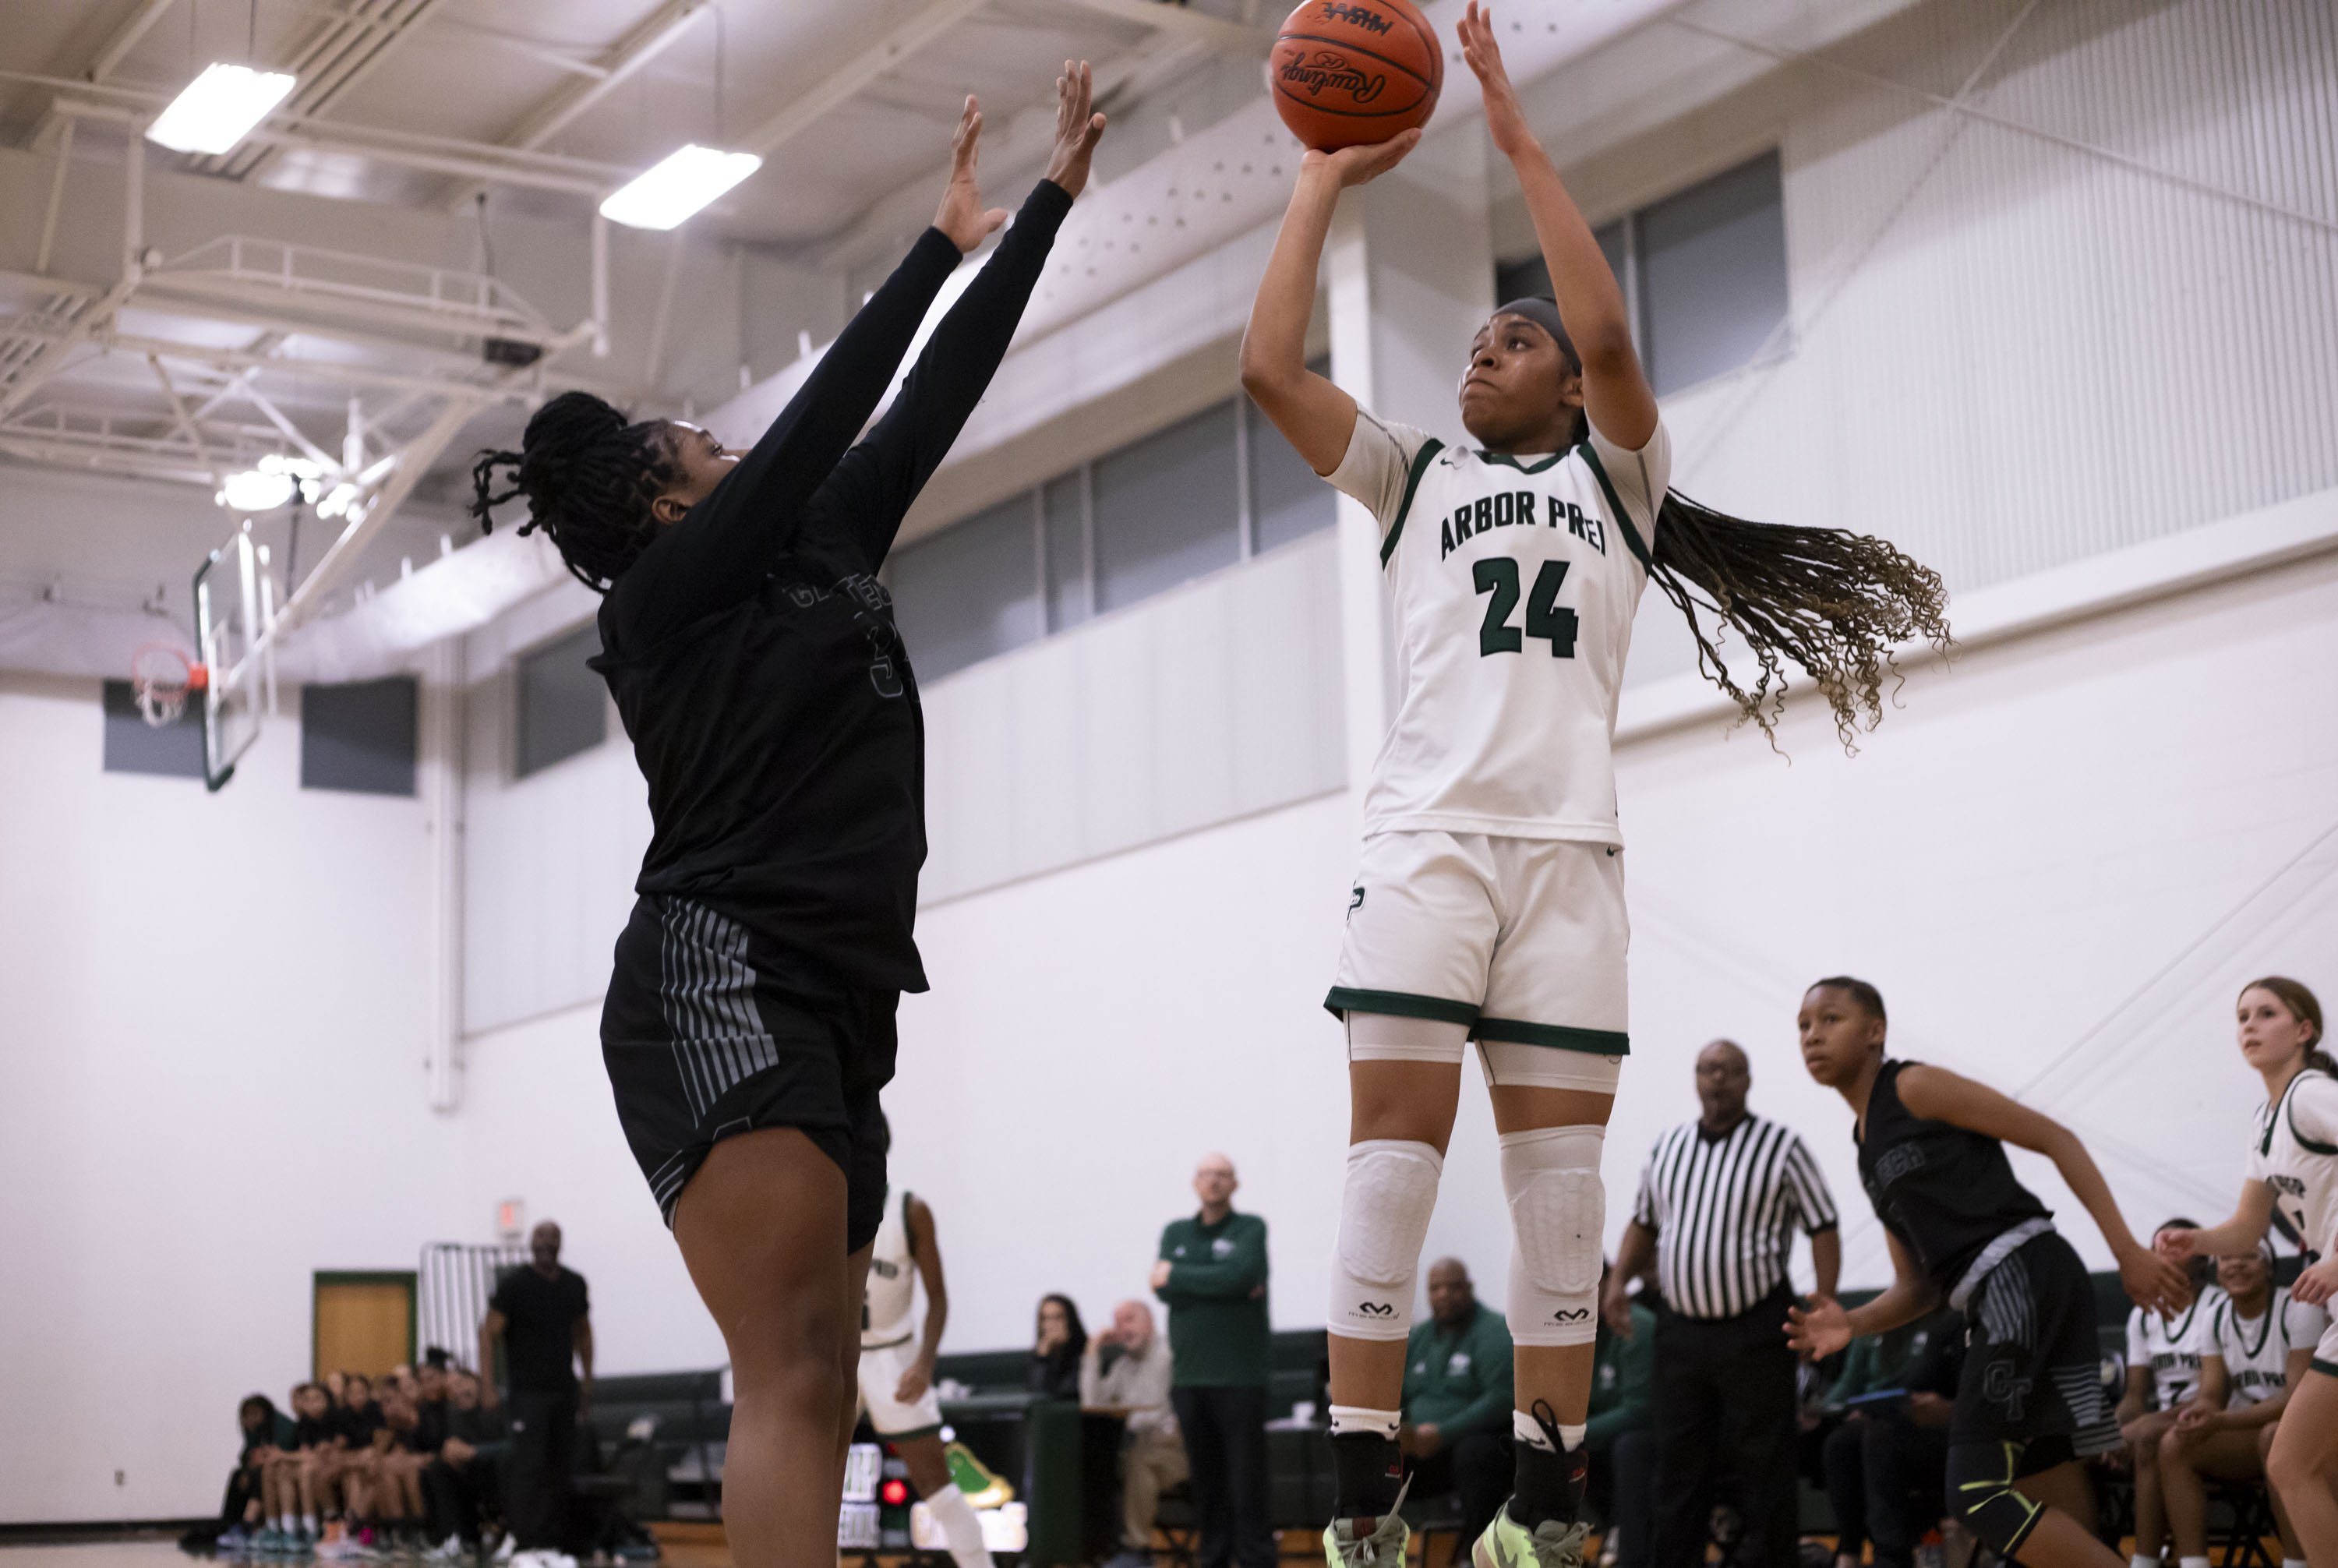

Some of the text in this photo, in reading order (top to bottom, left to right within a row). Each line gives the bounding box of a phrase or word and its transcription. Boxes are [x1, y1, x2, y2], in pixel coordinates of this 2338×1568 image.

[1280, 51, 1386, 104] Rawlings
[1441, 491, 1606, 563] ARBOR PRE
[1472, 556, 1580, 659] 24
